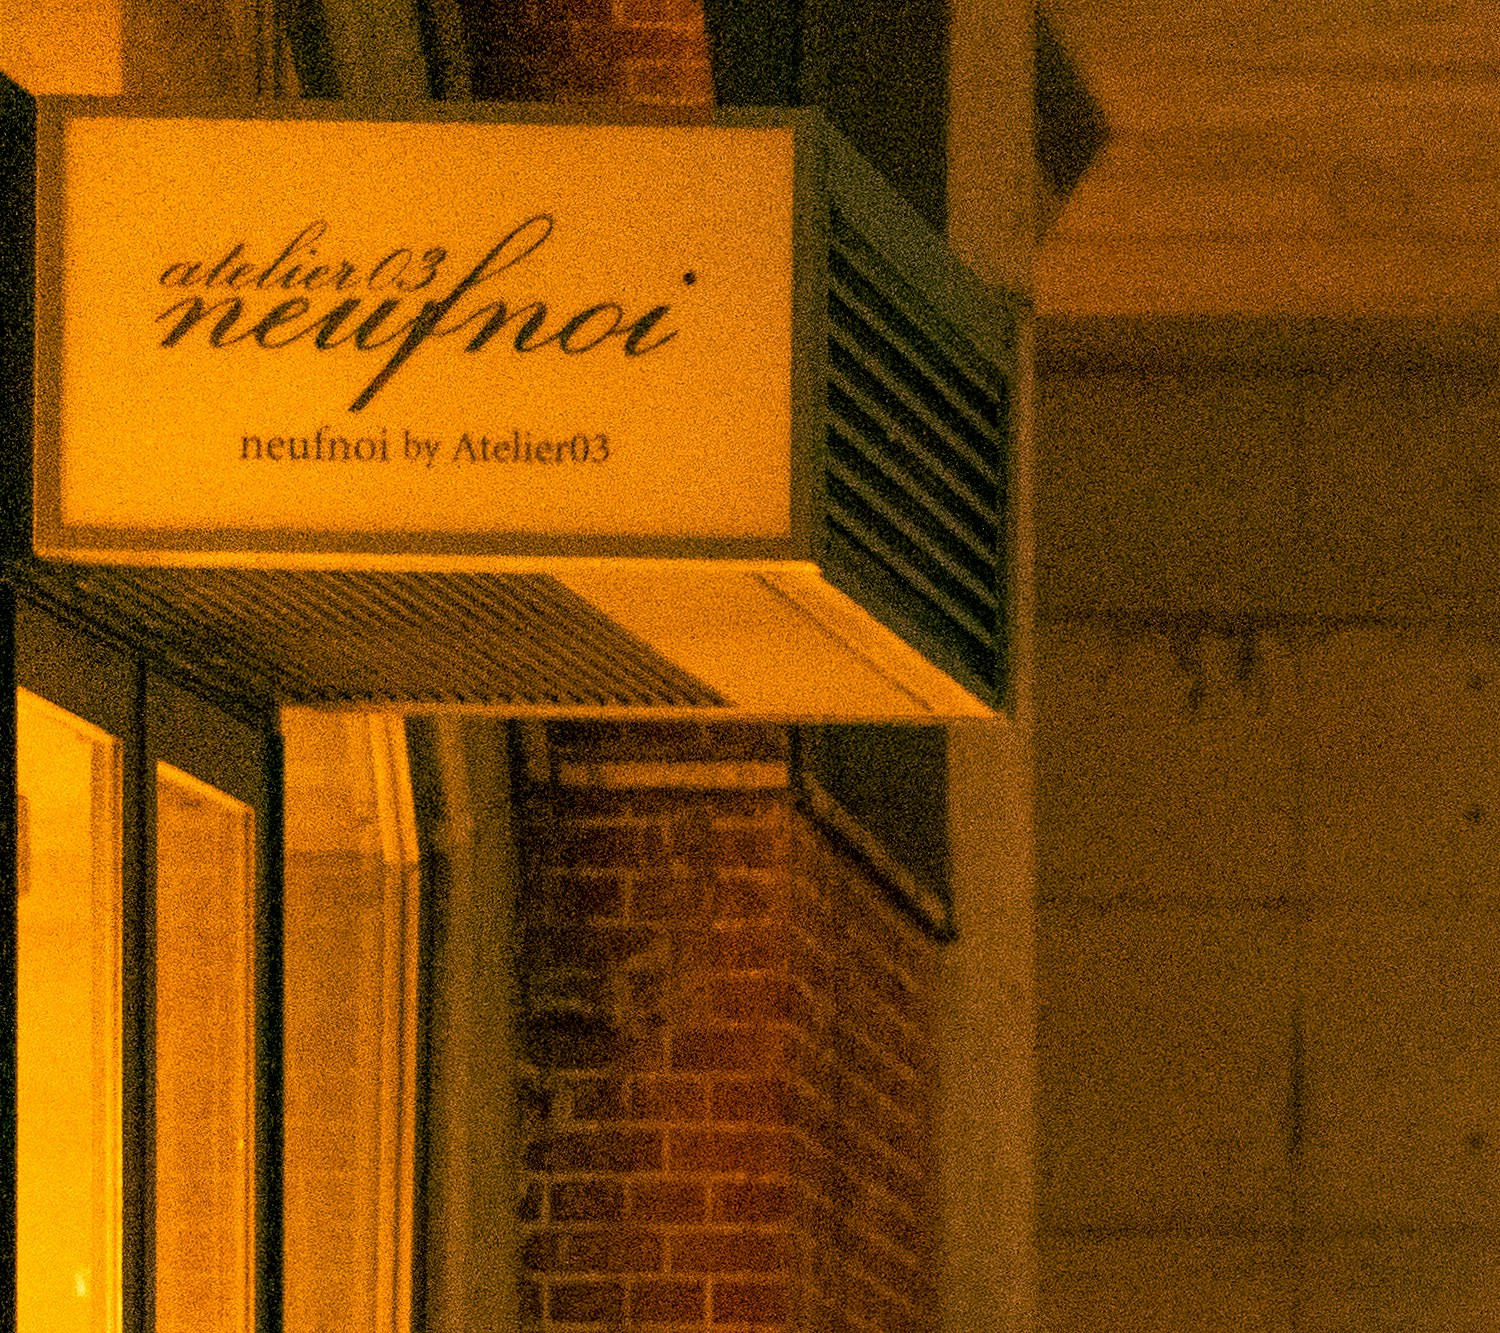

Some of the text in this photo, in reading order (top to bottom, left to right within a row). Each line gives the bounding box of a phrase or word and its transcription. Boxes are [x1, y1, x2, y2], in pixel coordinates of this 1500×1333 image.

[154, 213, 698, 413] neufnoi
[239, 424, 611, 470] neufnoi by Atelier03
